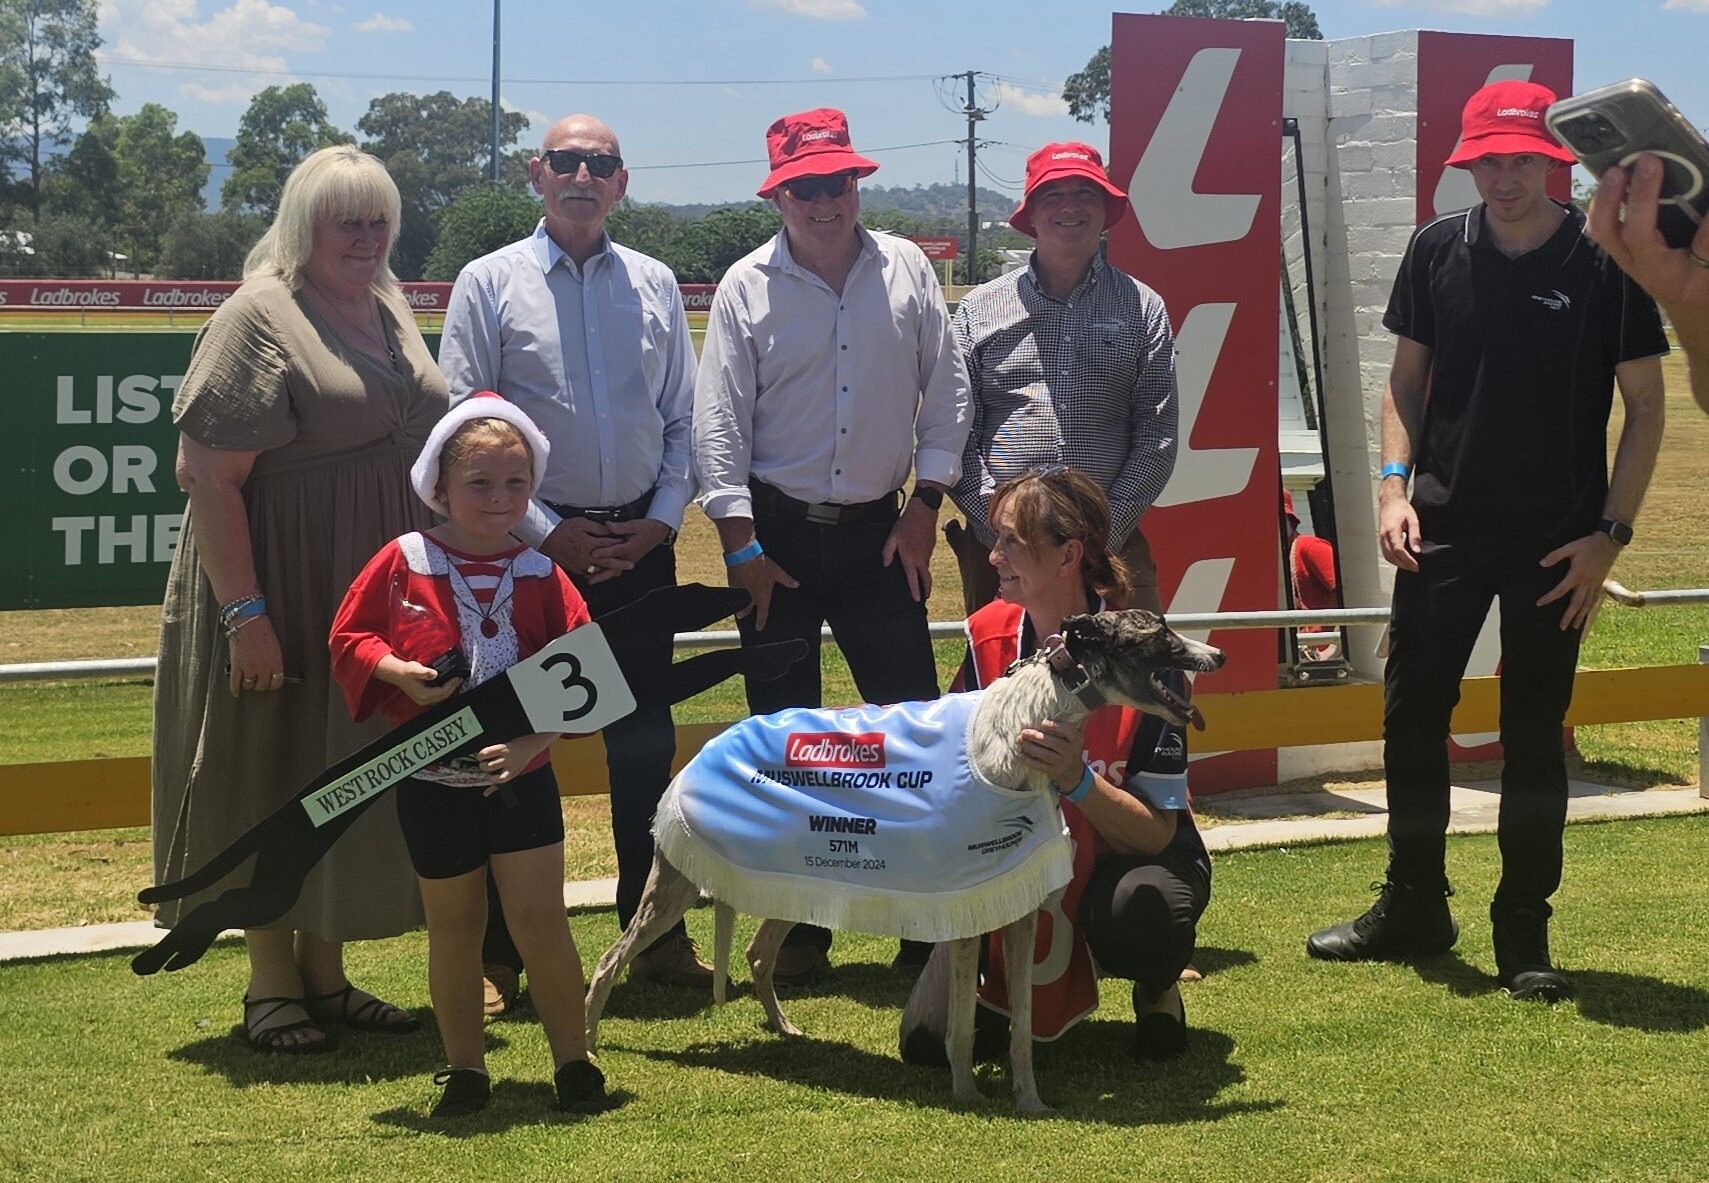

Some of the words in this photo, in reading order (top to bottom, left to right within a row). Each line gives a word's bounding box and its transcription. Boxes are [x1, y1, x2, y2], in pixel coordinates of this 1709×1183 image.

[31, 288, 121, 305] Ladbrokes
[53, 445, 158, 496] OR
[540, 652, 599, 722] 3
[789, 738, 880, 763] Ladbrokes
[316, 775, 367, 815] WEST
[363, 747, 416, 790] ROCK
[412, 716, 469, 761] CASEY
[750, 769, 893, 789] MUSWELLBROOK
[896, 770, 933, 789] CUP
[808, 815, 878, 835] WINNER
[829, 839, 859, 854] 571M
[804, 856, 814, 867] 15
[815, 856, 861, 869] December
[862, 859, 887, 870] 2024
